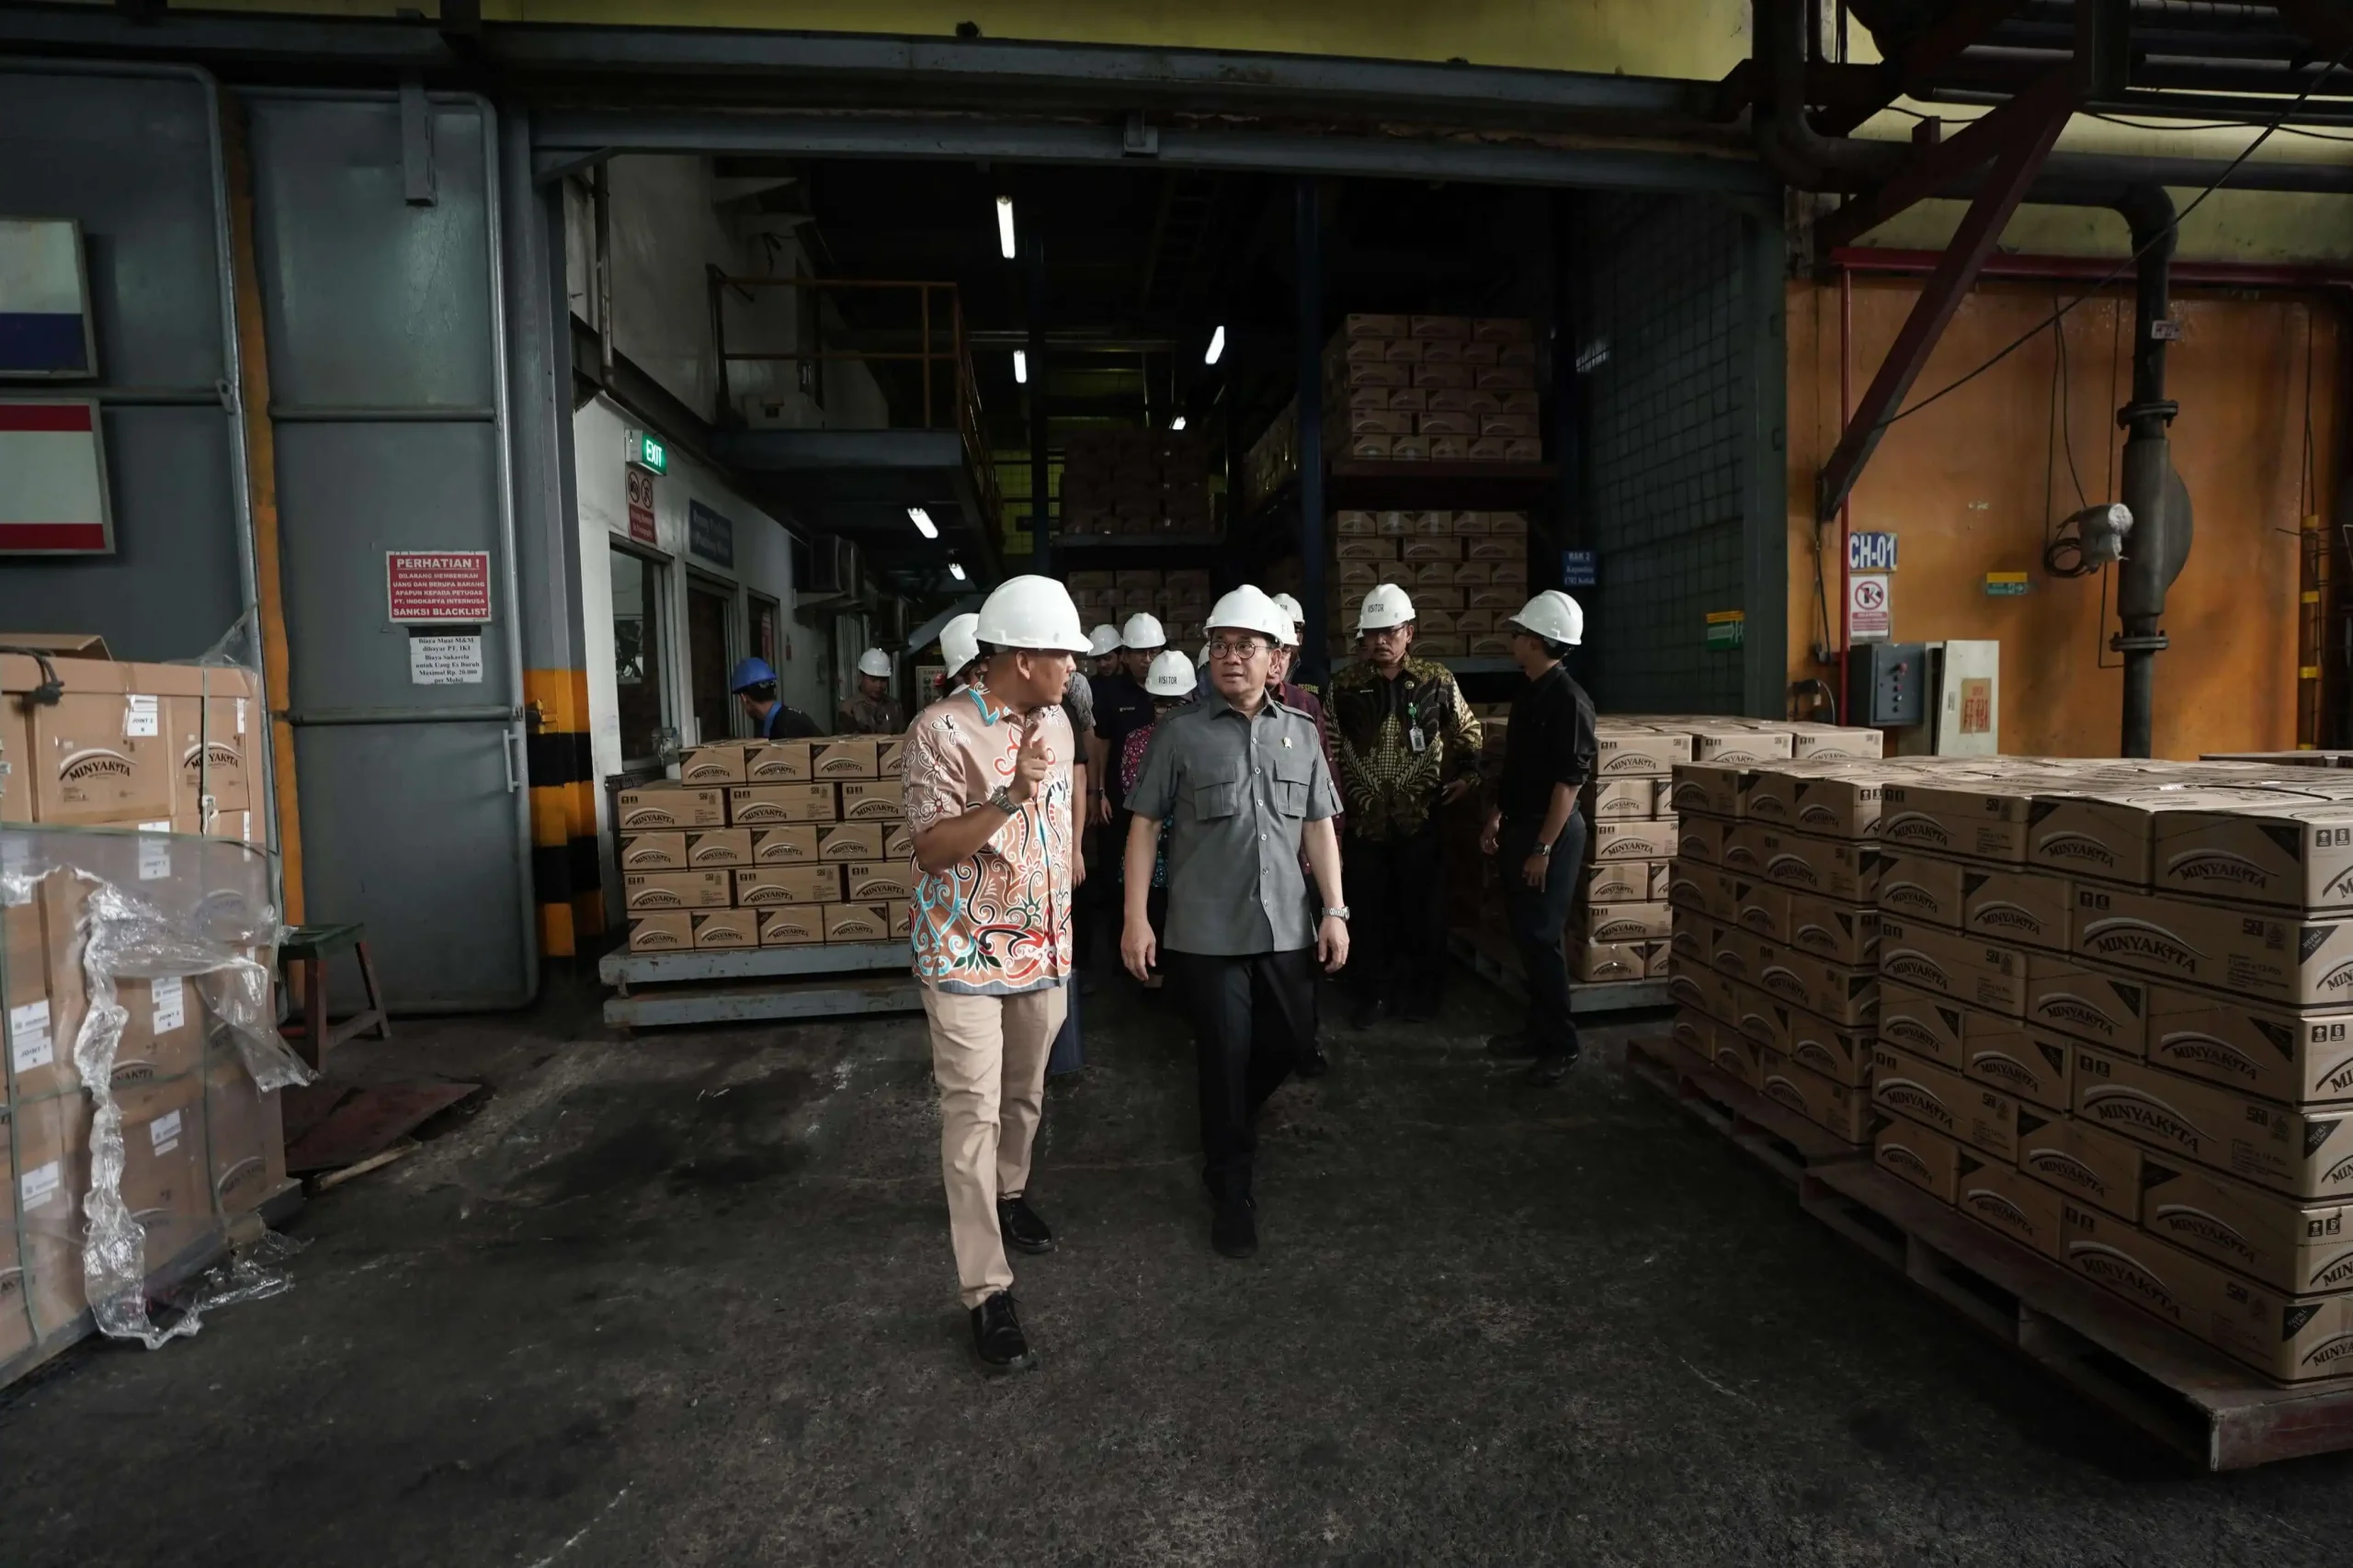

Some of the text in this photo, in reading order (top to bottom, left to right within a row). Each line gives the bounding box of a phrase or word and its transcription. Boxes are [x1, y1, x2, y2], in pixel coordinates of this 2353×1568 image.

[645, 438, 663, 468] EXIT
[1848, 534, 1895, 569] CH-01
[396, 558, 472, 568] PERHATIAN
[393, 608, 487, 616] SANKSI BLACKLIST
[1367, 604, 1384, 613] VISITOR
[1158, 676, 1177, 685] VISITOR
[69, 760, 131, 781] MINYAKITA
[693, 767, 732, 780] MINYAKITA
[826, 762, 863, 774] MINYAKITA
[1610, 756, 1656, 772] MINYAKITA
[744, 809, 788, 822] MINYAKITA
[857, 803, 899, 817] MINYAKITA
[1607, 801, 1640, 811] MINYAKITA
[631, 814, 676, 827] MINYAKITA
[1893, 824, 1948, 846] MINYAKITA
[634, 854, 672, 864] MINYAKITA
[1608, 842, 1654, 857] MINYAKITA
[2048, 843, 2114, 868] MINYAKITA
[2179, 862, 2267, 889] MINYAKITA
[749, 890, 793, 903] MINYAKITA
[861, 884, 904, 898] MINYAKITA
[1599, 885, 1634, 895] MINYAKITA
[638, 895, 682, 906] MINYAKITA
[1892, 891, 1938, 913] MINYAKITA
[1601, 923, 1647, 938] MINYAKITA
[1982, 913, 2040, 936] MINYAKITA
[2302, 929, 2323, 949] REFILL
[2097, 935, 2196, 974] MINYAKITA
[1892, 961, 1948, 990] MINYAKITA
[2047, 1006, 2113, 1037] MINYAKITA
[2172, 1046, 2257, 1080] MINYAKITA
[1981, 1062, 2039, 1093] MINYAKITA
[1887, 1091, 1953, 1131] MINYAKITA
[2245, 1106, 2268, 1127] SNI
[2096, 1104, 2199, 1154] MINYAKITA
[2308, 1124, 2327, 1142] REFILL
[2039, 1160, 2105, 1199] MINYAKITA
[2168, 1217, 2256, 1265] MINYAKITA
[2082, 1257, 2181, 1321] MINYAKITA
